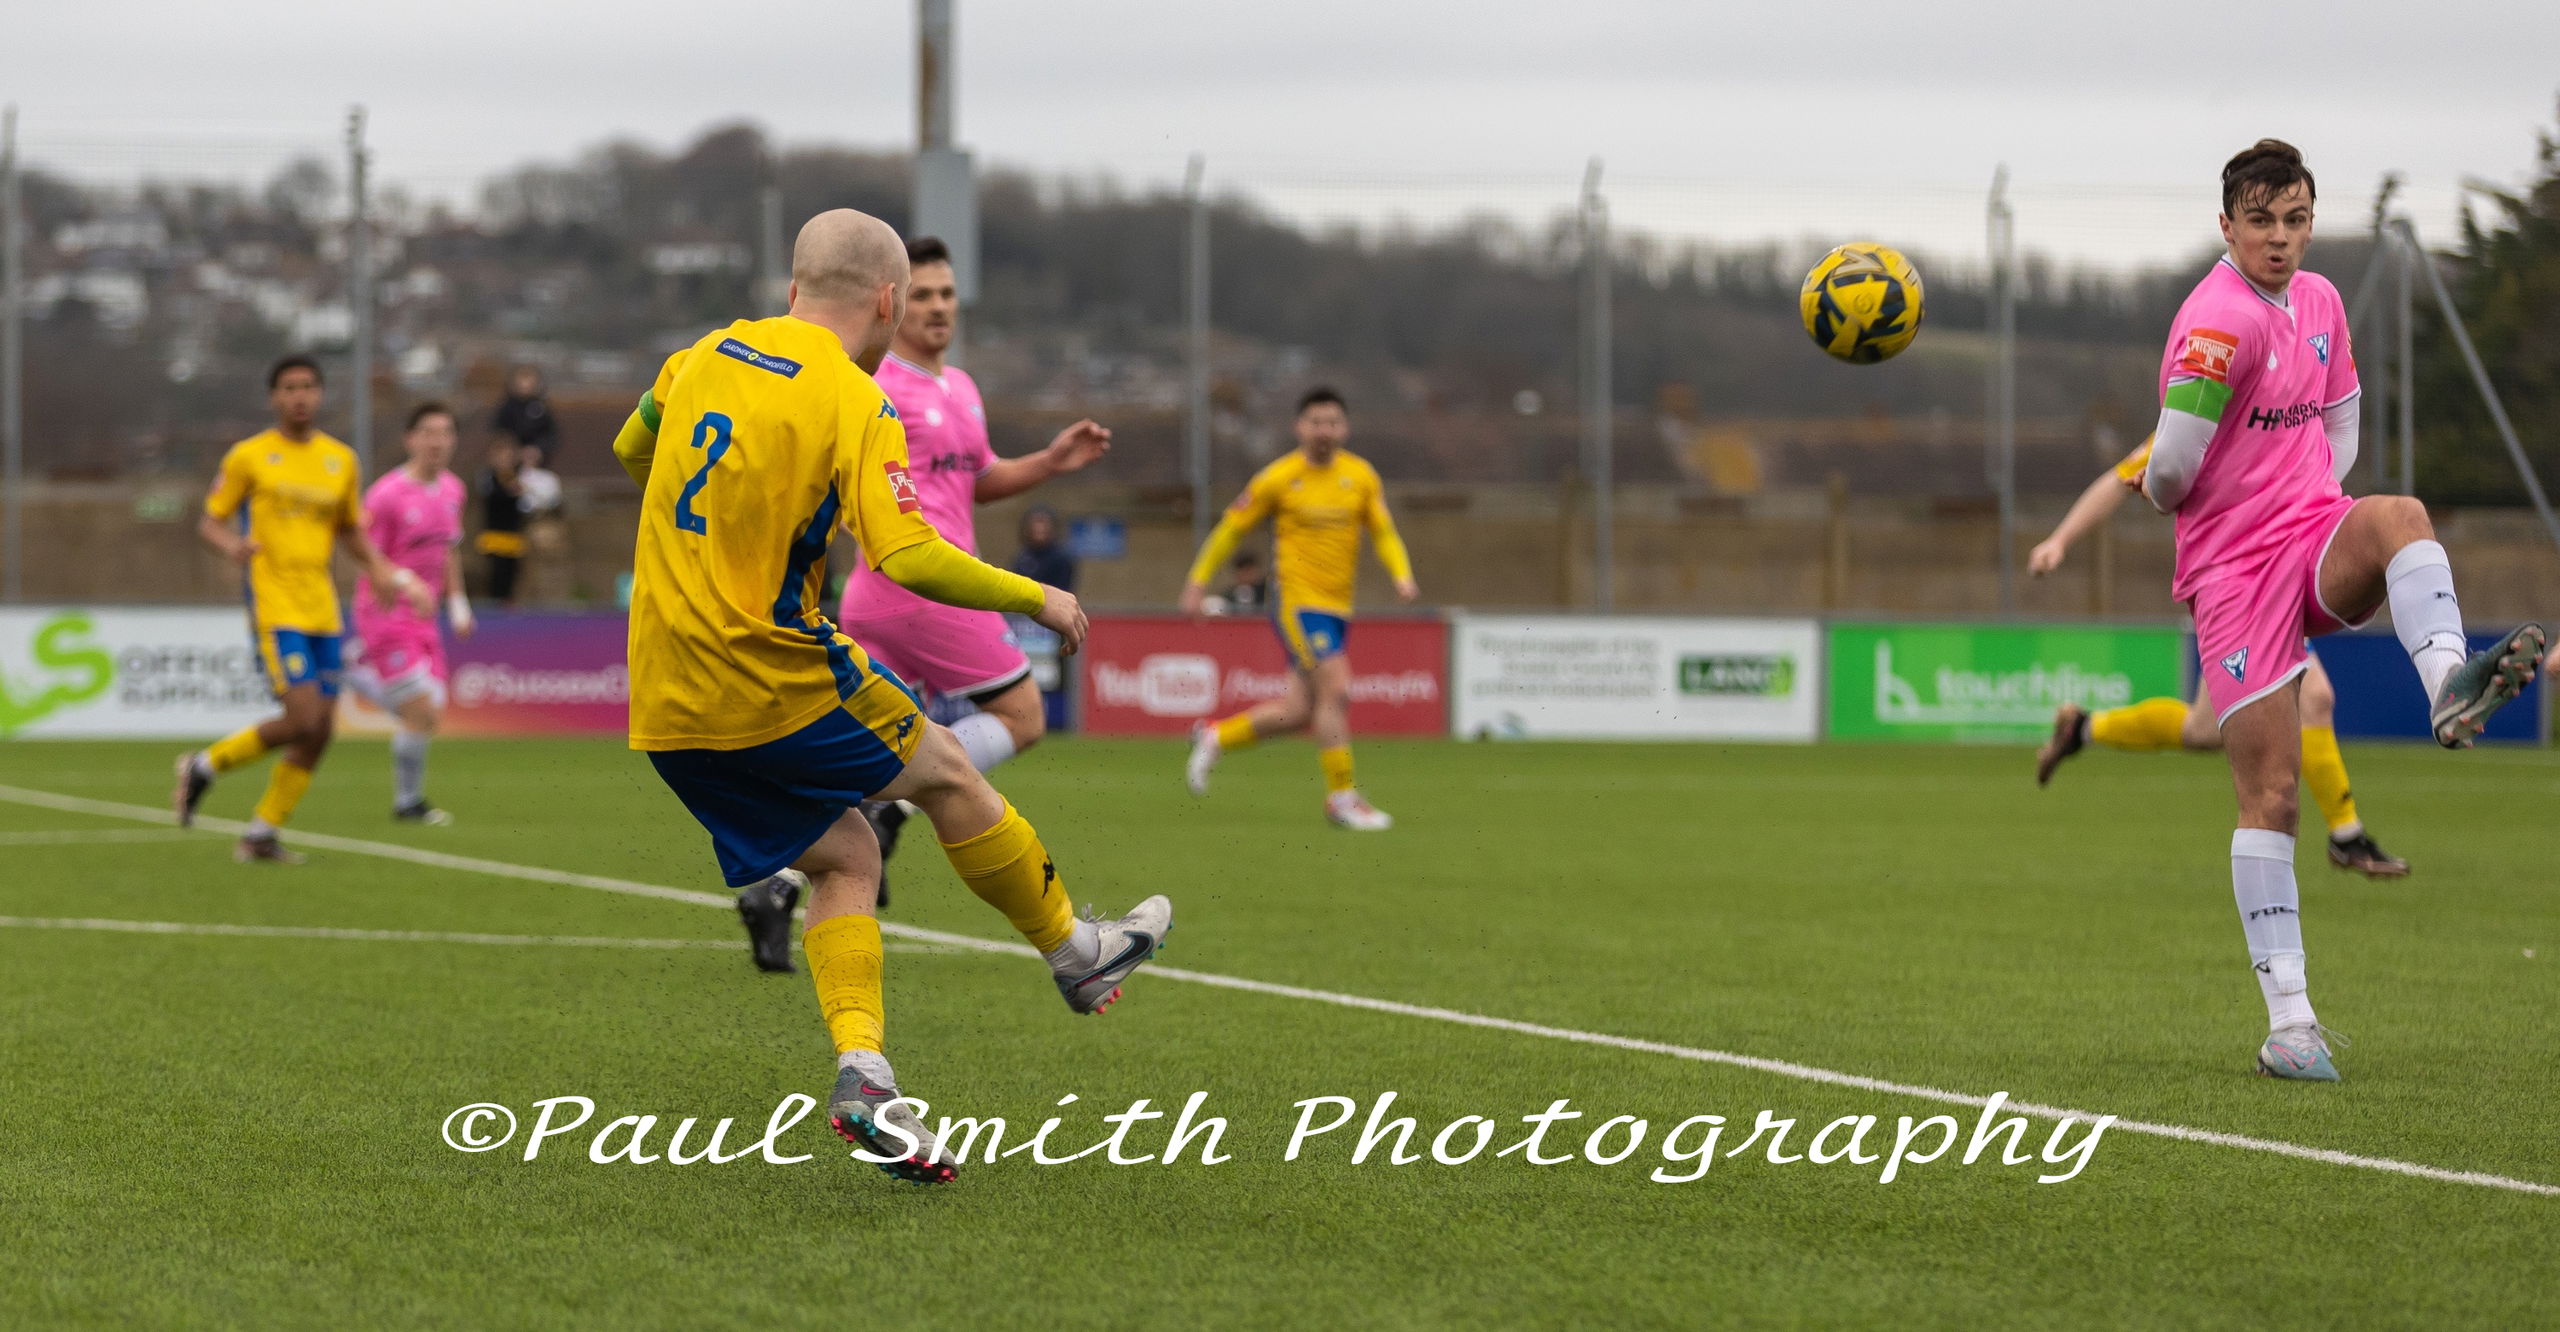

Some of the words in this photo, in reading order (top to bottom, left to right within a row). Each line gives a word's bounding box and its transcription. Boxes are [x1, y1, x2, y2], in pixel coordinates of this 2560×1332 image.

[722, 341, 751, 357] GARDNER
[674, 411, 733, 536] 2
[1936, 663, 2131, 703] touchline
